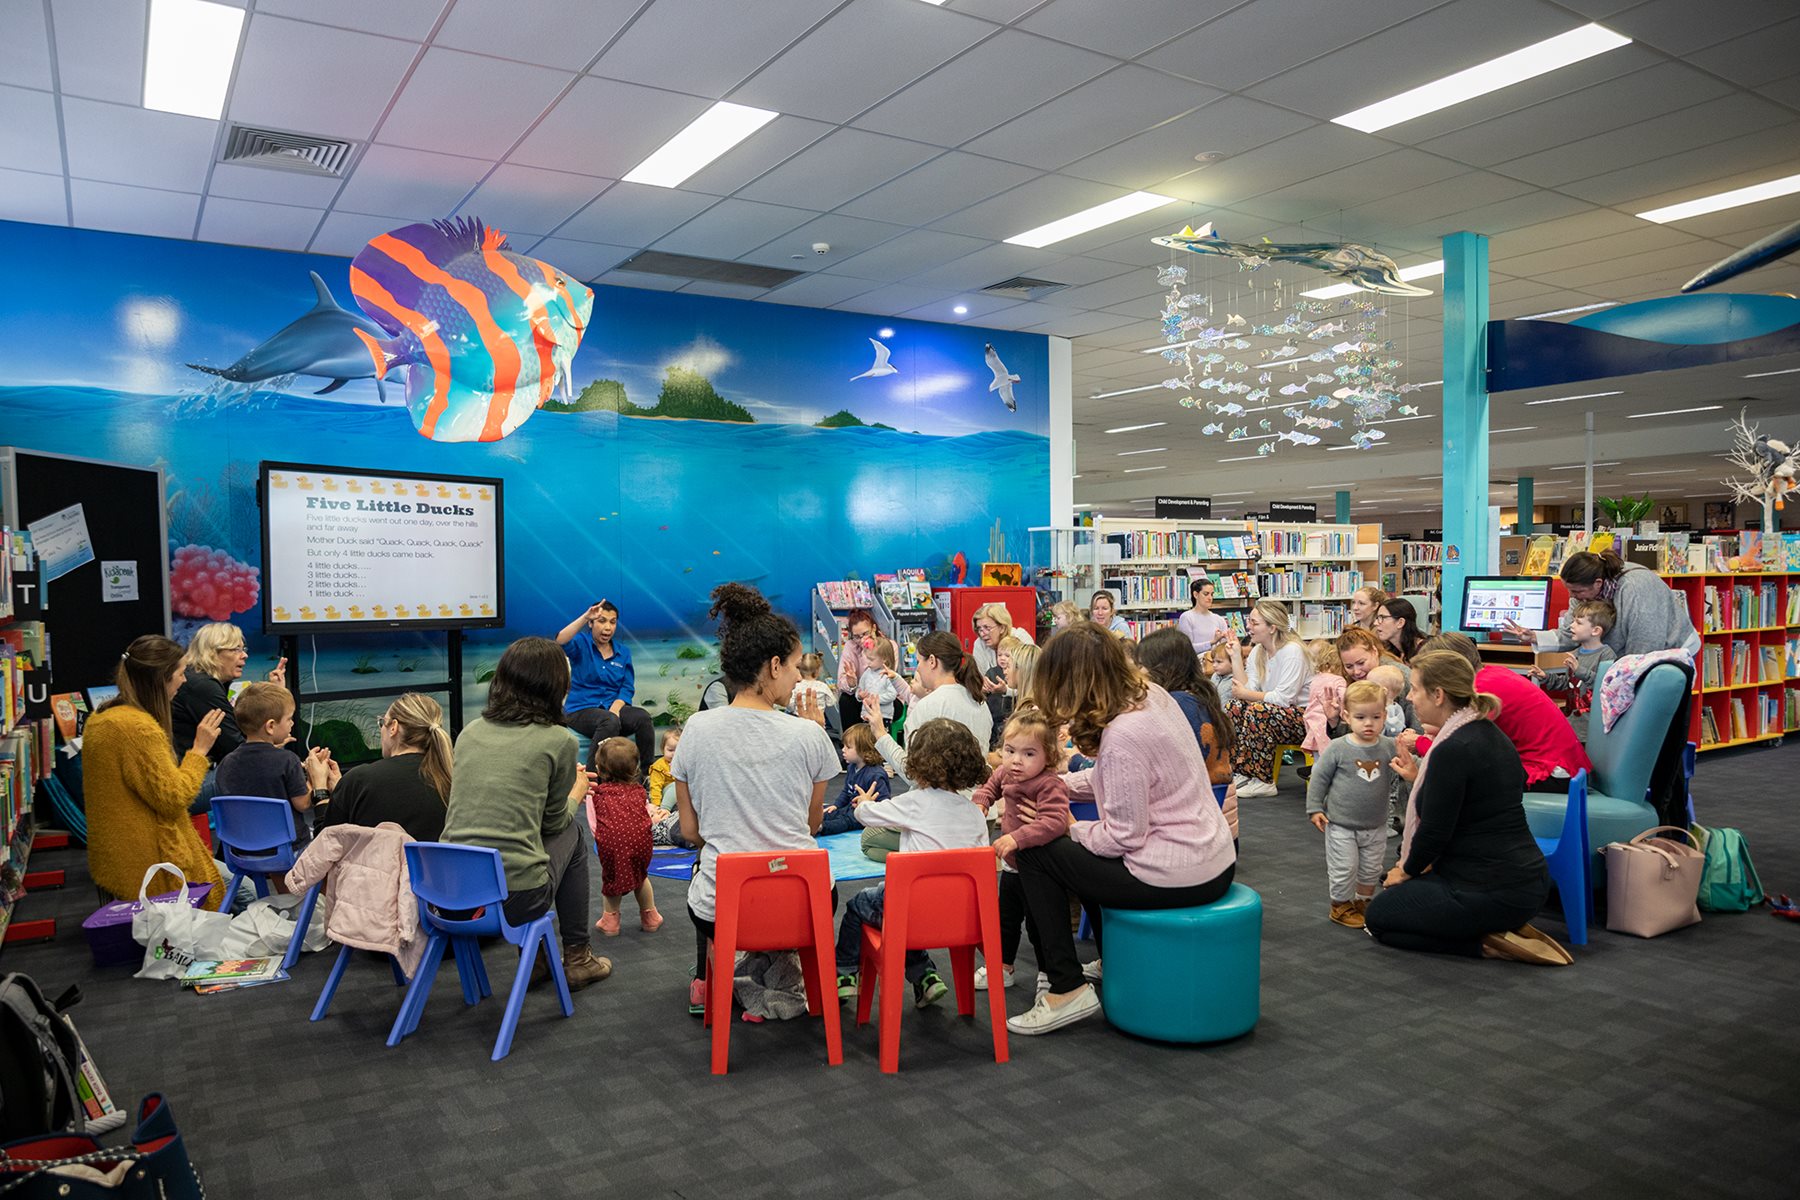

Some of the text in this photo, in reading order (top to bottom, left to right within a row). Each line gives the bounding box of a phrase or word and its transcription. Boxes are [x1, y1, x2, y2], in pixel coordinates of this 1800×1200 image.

[306, 496, 474, 516] Five Little Ducks
[307, 513, 478, 528] Five little ducks went out one day, over the hills
[306, 523, 358, 534] and far away
[306, 535, 335, 545] Mother
[337, 536, 358, 545] Duck
[358, 537, 375, 546] said
[1634, 543, 1648, 552] Junior
[306, 548, 322, 557] But
[323, 549, 342, 559] only
[342, 549, 349, 558] 4
[350, 549, 365, 558] little
[366, 550, 391, 558] ducks
[392, 551, 413, 559] came
[315, 561, 331, 570] little
[307, 571, 314, 579] 3
[315, 571, 331, 579] little
[902, 568, 925, 576] AQUILA
[307, 580, 314, 588] 2
[315, 580, 331, 589] little
[16, 583, 36, 605] T
[308, 590, 314, 598] 1
[315, 589, 331, 598] little
[332, 589, 354, 598] duck
[28, 683, 47, 703] U
